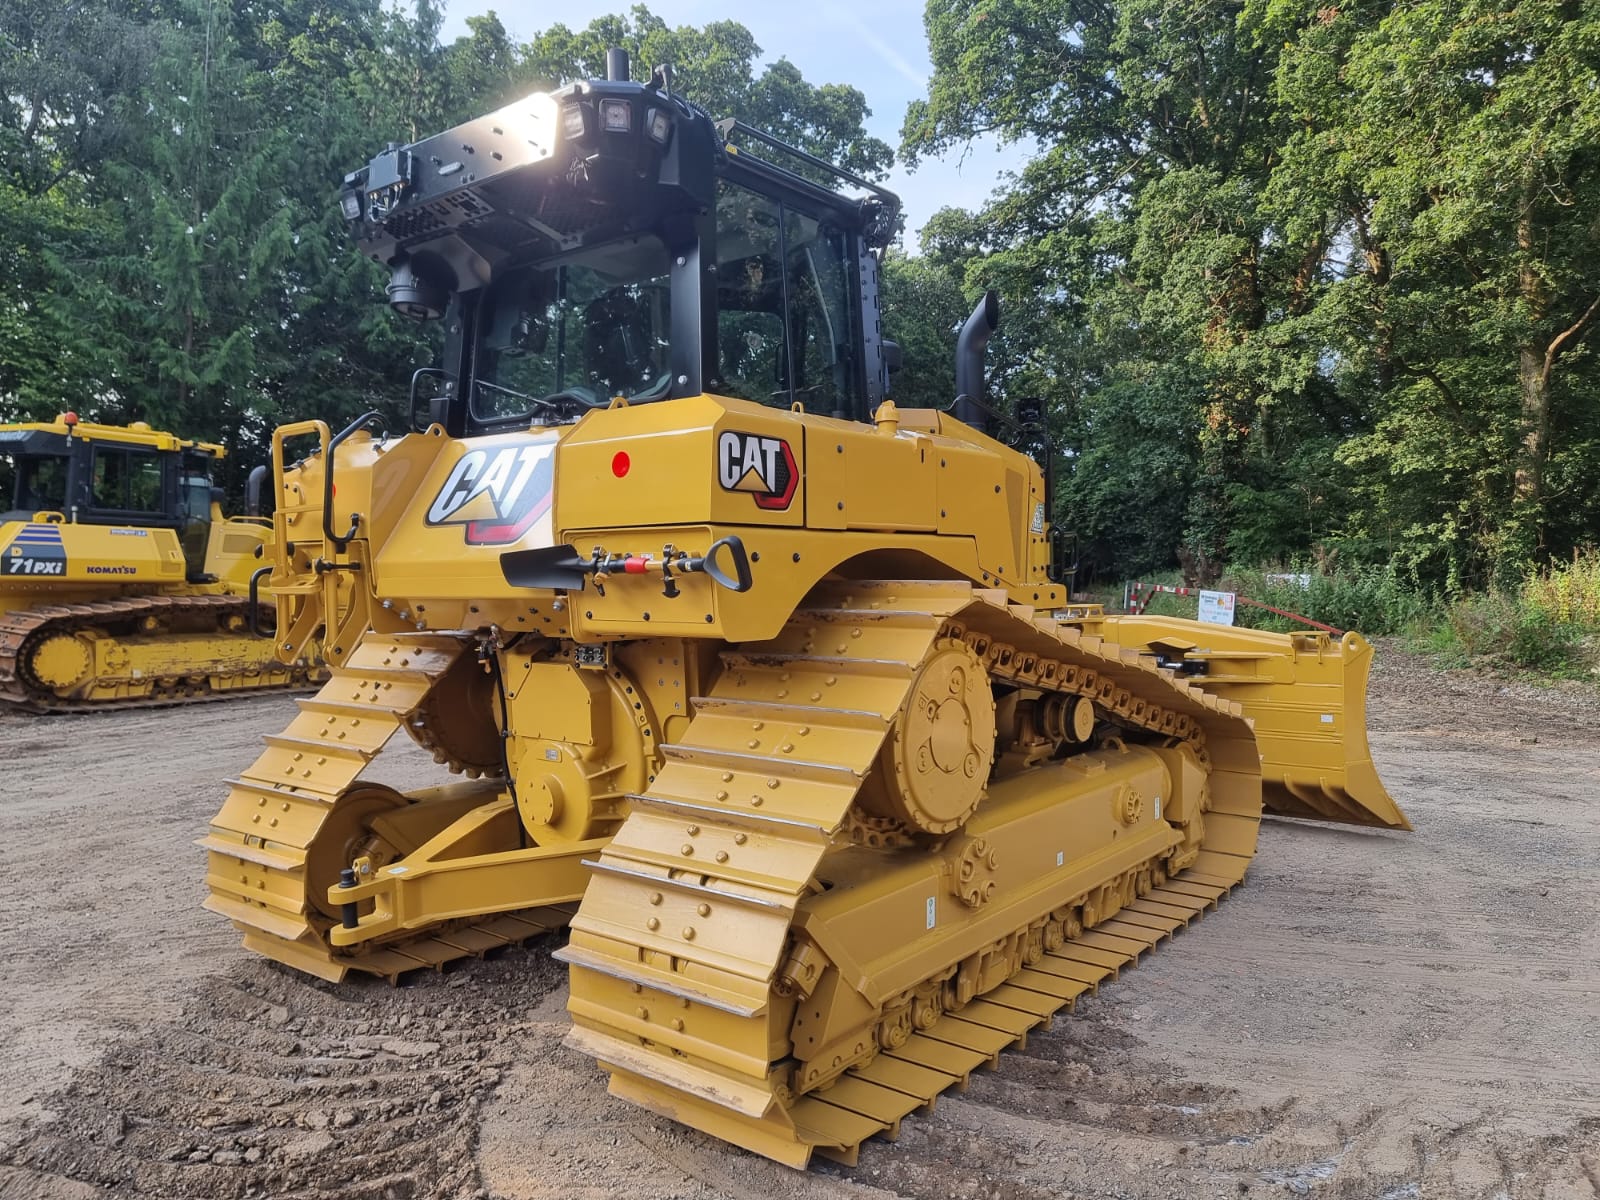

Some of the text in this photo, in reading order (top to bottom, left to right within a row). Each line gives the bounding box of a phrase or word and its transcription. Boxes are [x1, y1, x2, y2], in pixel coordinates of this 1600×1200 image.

[719, 432, 781, 493] CAT
[428, 443, 555, 523] CAT
[11, 547, 23, 557] D
[9, 558, 62, 574] 71PXi
[87, 565, 136, 575] KOMATSU
